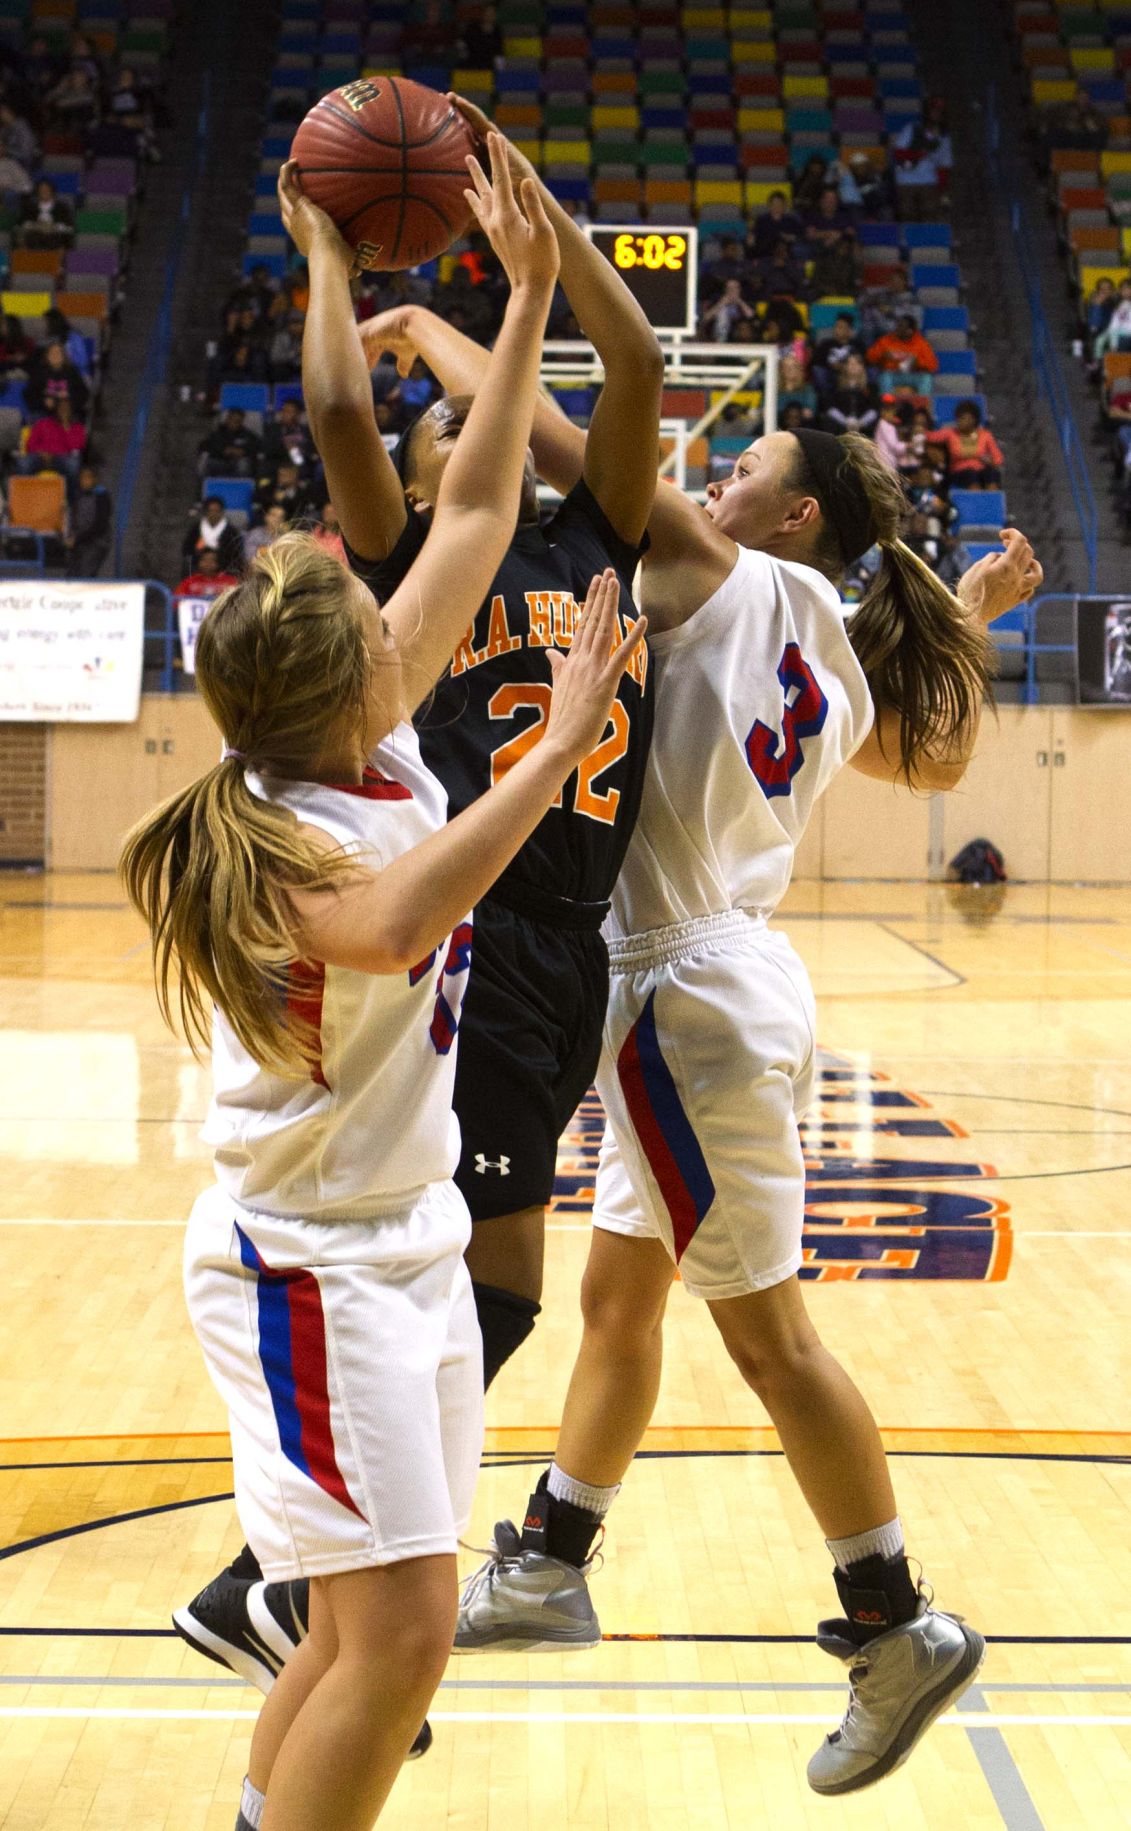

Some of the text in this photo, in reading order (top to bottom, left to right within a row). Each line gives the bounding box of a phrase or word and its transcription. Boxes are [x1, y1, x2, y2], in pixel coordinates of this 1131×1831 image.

[614, 234, 687, 270] 6:02
[488, 683, 630, 826] 22
[744, 642, 829, 800] 3
